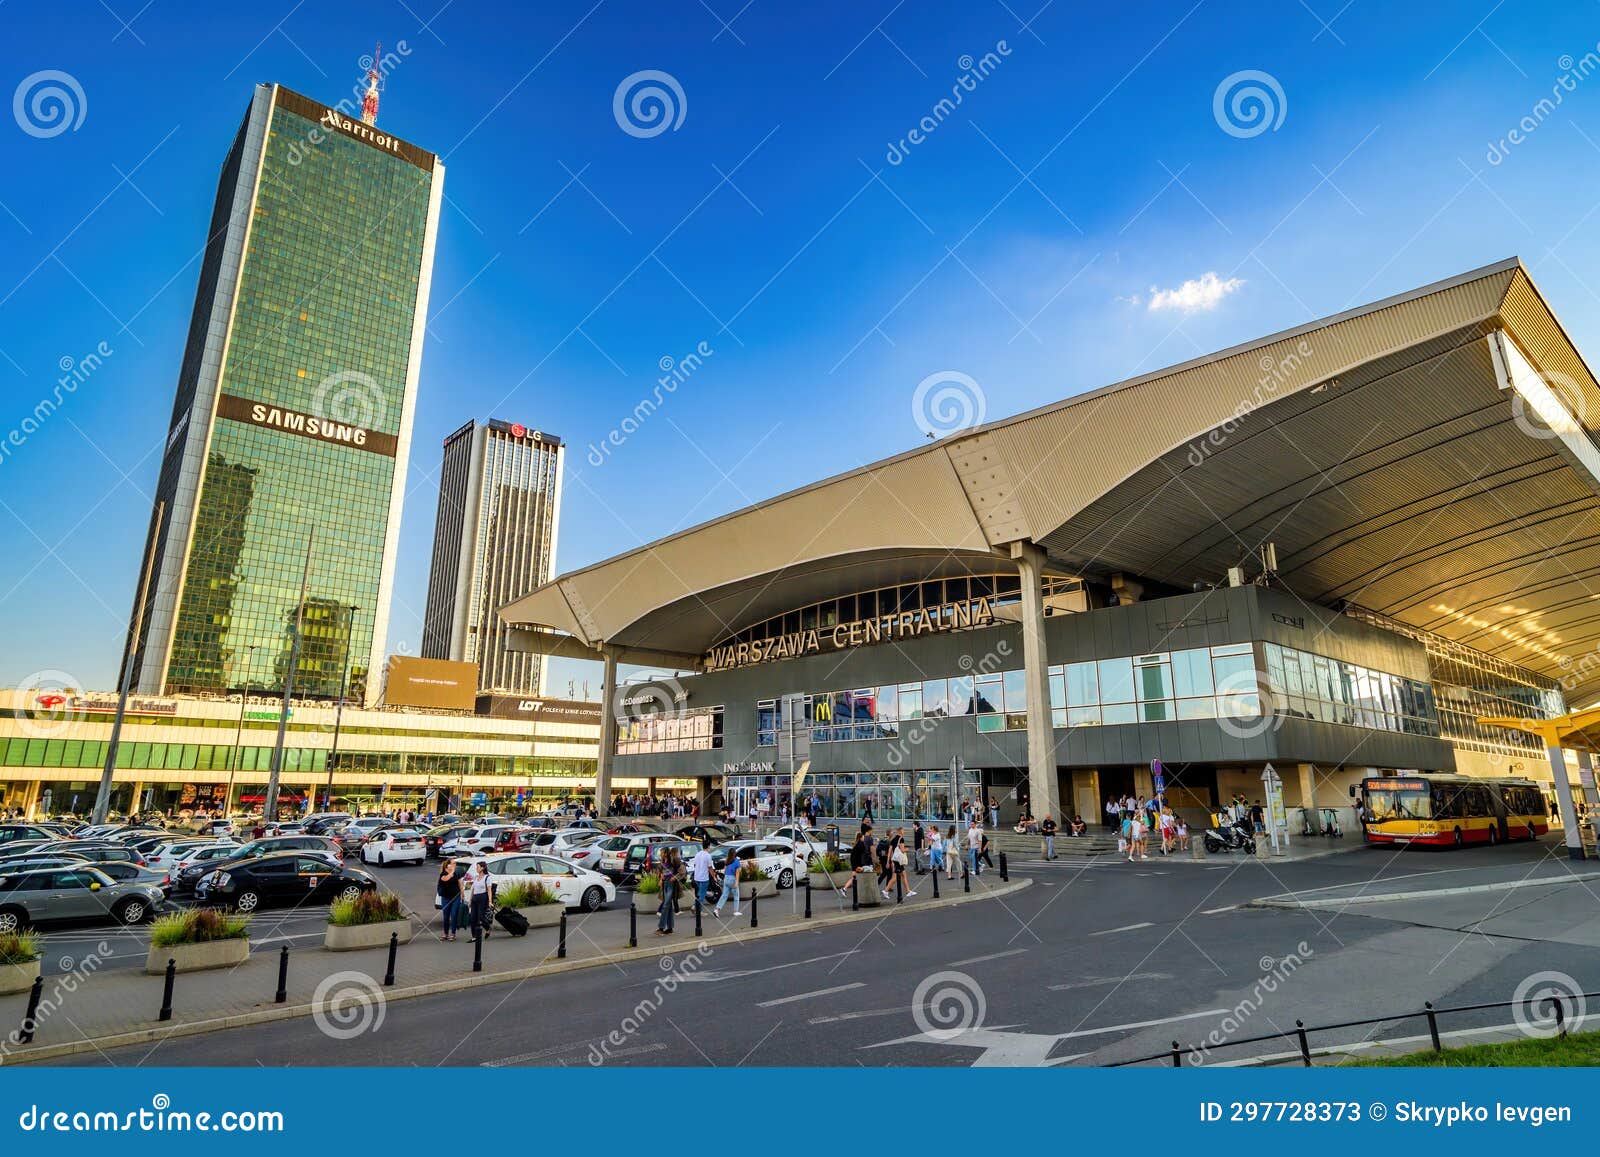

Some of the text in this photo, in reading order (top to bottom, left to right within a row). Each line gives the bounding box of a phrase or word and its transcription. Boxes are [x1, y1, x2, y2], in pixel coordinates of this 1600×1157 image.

[320, 109, 400, 152] Marriott
[251, 404, 366, 445] SAMSUNG
[526, 428, 542, 441] LG
[711, 597, 994, 667] WARSZAWA CENTRALNA
[518, 700, 543, 712] LOT
[723, 761, 775, 773] ING BANK
